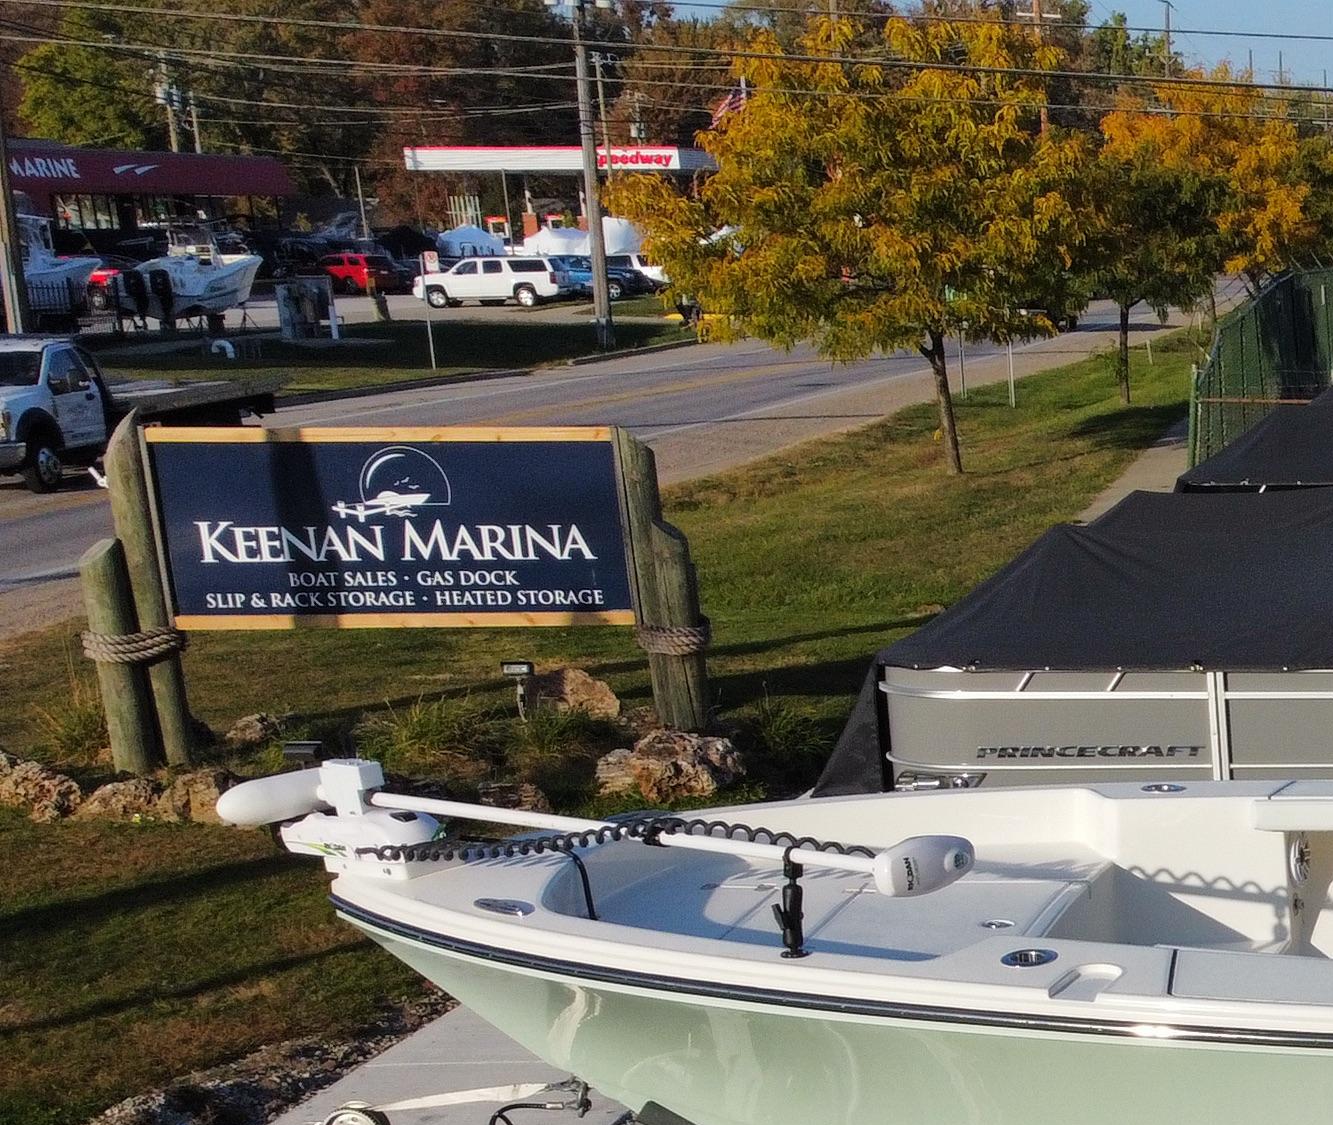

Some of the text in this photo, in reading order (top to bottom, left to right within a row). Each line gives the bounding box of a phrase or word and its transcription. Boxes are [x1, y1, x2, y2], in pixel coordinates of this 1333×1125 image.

[596, 151, 673, 168] peedway
[193, 518, 599, 563] KEENAN MARINA
[288, 570, 521, 588] BOAT SALES GAS DOCK
[206, 589, 605, 609] SLIP & RACK STORAGE HEATED STORAGE
[976, 745, 1205, 759] PRINCECRAFT
